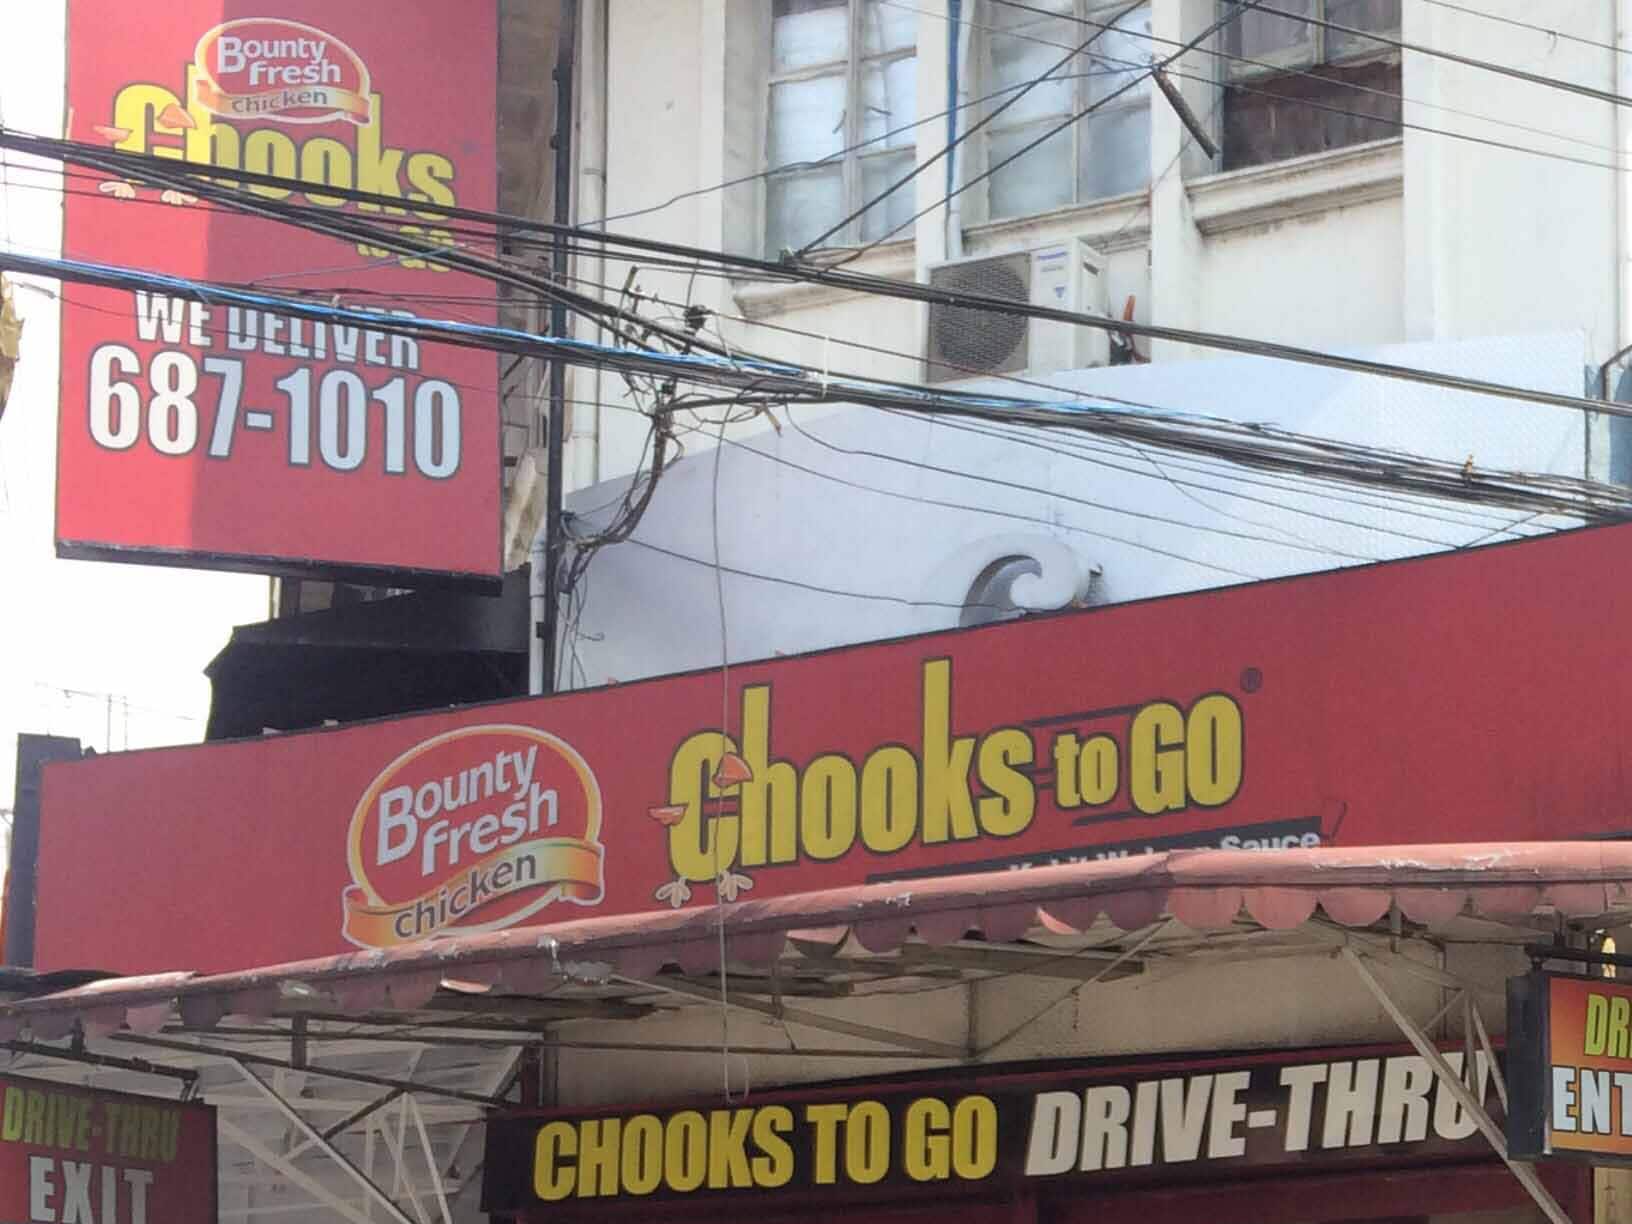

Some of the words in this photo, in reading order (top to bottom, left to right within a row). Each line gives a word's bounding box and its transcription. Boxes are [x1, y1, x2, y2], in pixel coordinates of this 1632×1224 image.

[217, 37, 326, 74] Bounty
[231, 89, 328, 113] chicken
[89, 345, 463, 479] 687-1010
[376, 744, 539, 867] Bounty
[1053, 732, 1120, 808] to
[1131, 695, 1243, 815] GO
[394, 851, 537, 938] chicken
[2, 1087, 179, 1164] DRIVE-THRU
[534, 1105, 794, 1201] CHOOKS
[806, 1100, 890, 1184] TO
[905, 1095, 998, 1182] GO
[1025, 1050, 1490, 1177] DRIVE-THRU
